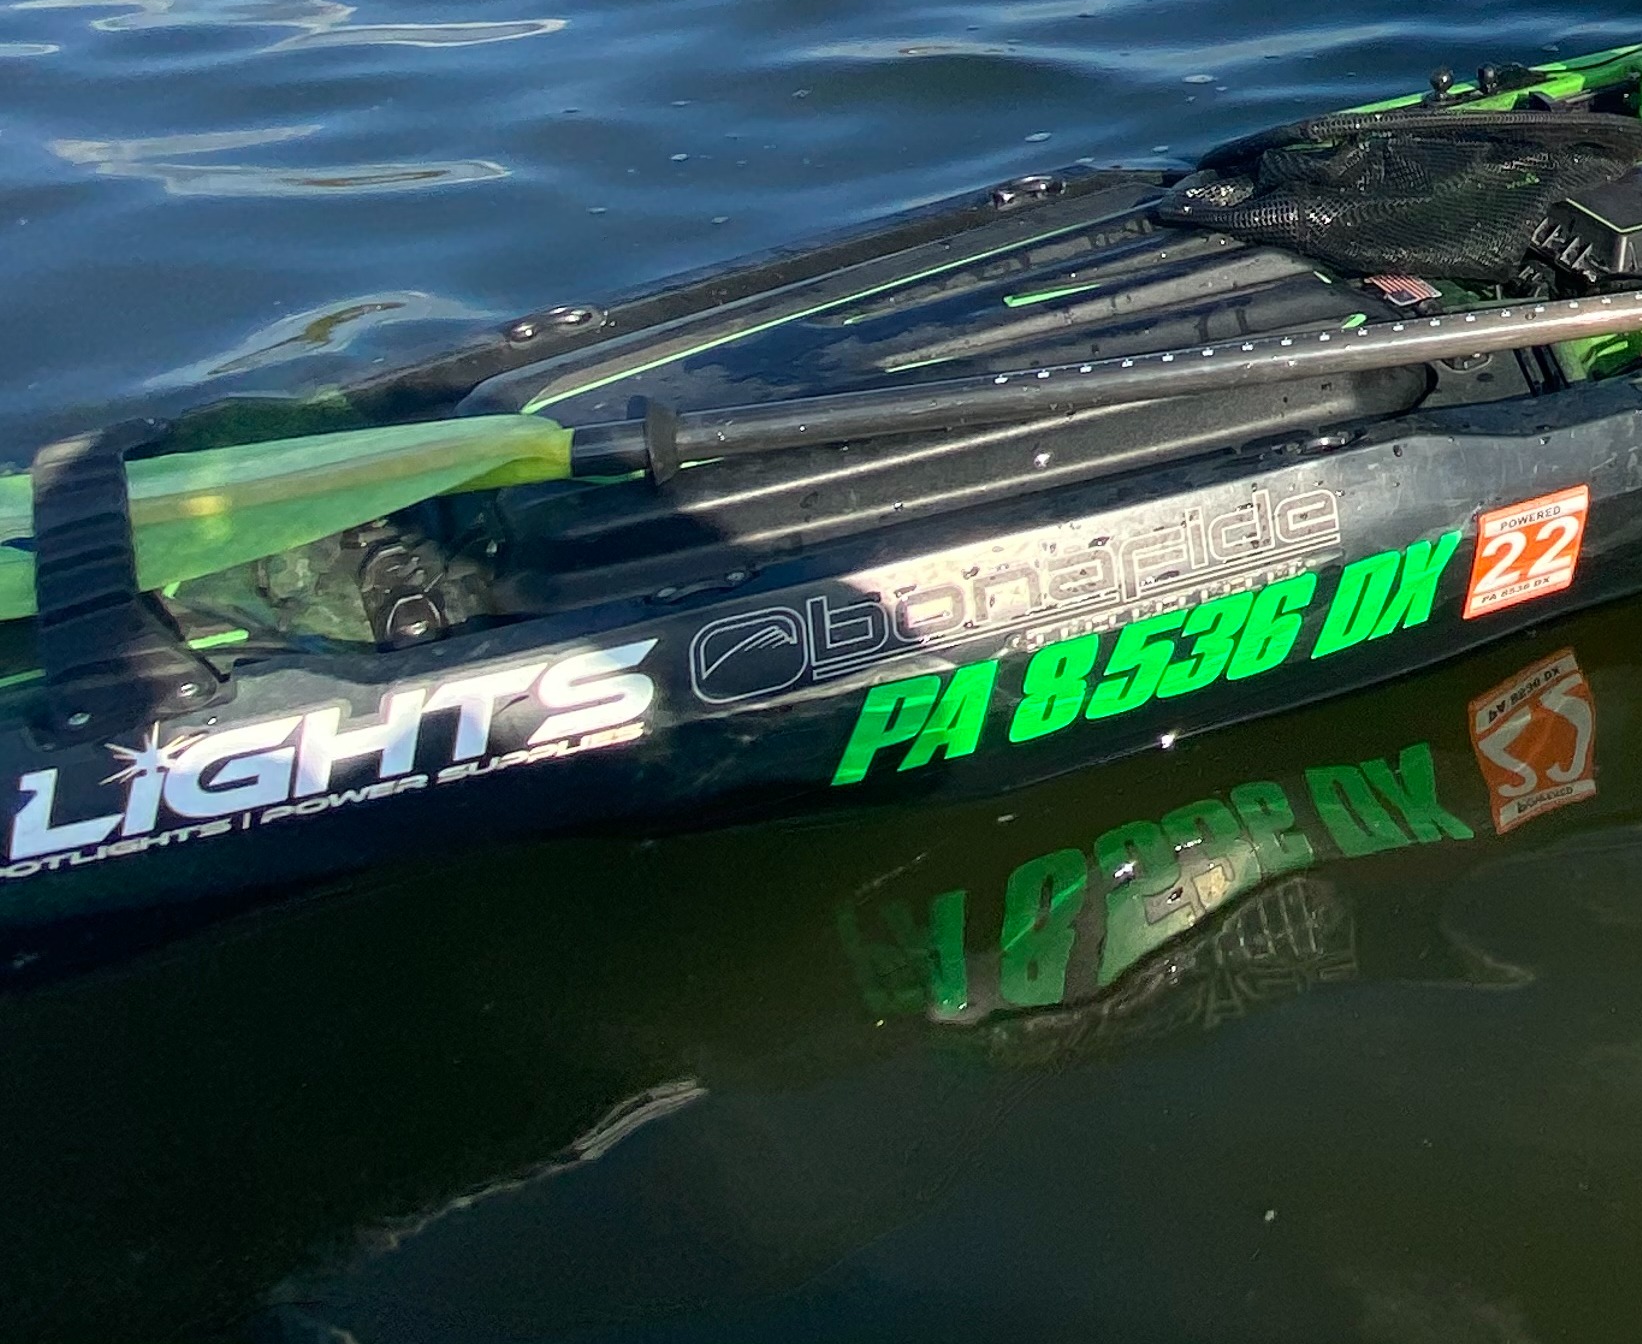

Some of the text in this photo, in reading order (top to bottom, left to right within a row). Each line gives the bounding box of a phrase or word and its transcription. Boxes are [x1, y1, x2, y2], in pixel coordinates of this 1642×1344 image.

[1473, 515, 1579, 595] 22
[1499, 505, 1561, 531] POWERED
[1533, 576, 1551, 588] DX
[830, 659, 998, 786] PA
[1009, 569, 1316, 744] 8536
[1310, 529, 1463, 662] DX
[260, 773, 429, 825] POWER
[437, 721, 646, 785] SUPPLIES
